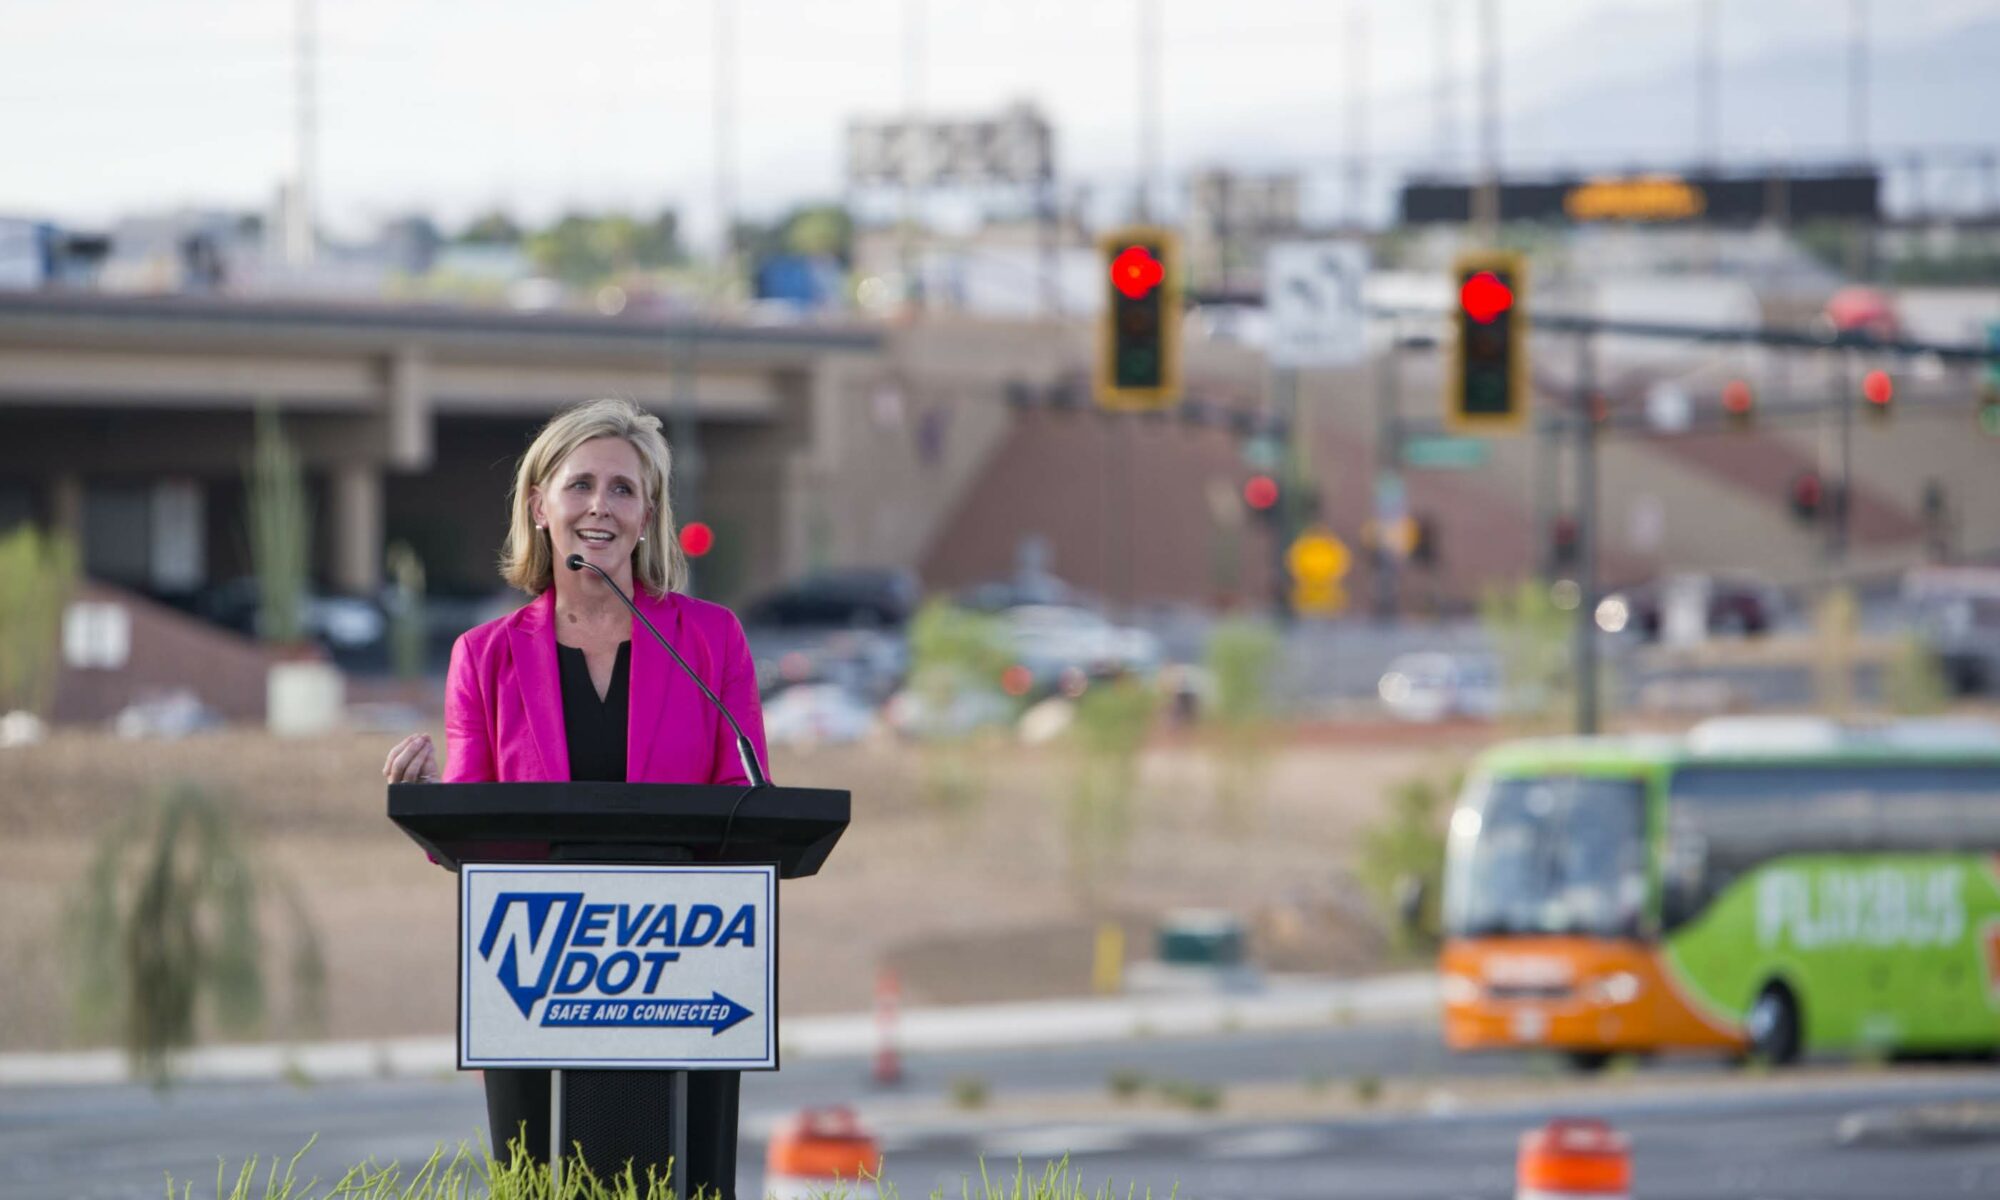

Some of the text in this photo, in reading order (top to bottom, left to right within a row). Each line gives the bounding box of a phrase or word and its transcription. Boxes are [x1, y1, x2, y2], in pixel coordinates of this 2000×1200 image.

[478, 892, 755, 1020] NEVADA
[553, 951, 680, 995] DOT
[548, 1004, 731, 1022] SAFE AND CONNECTED
